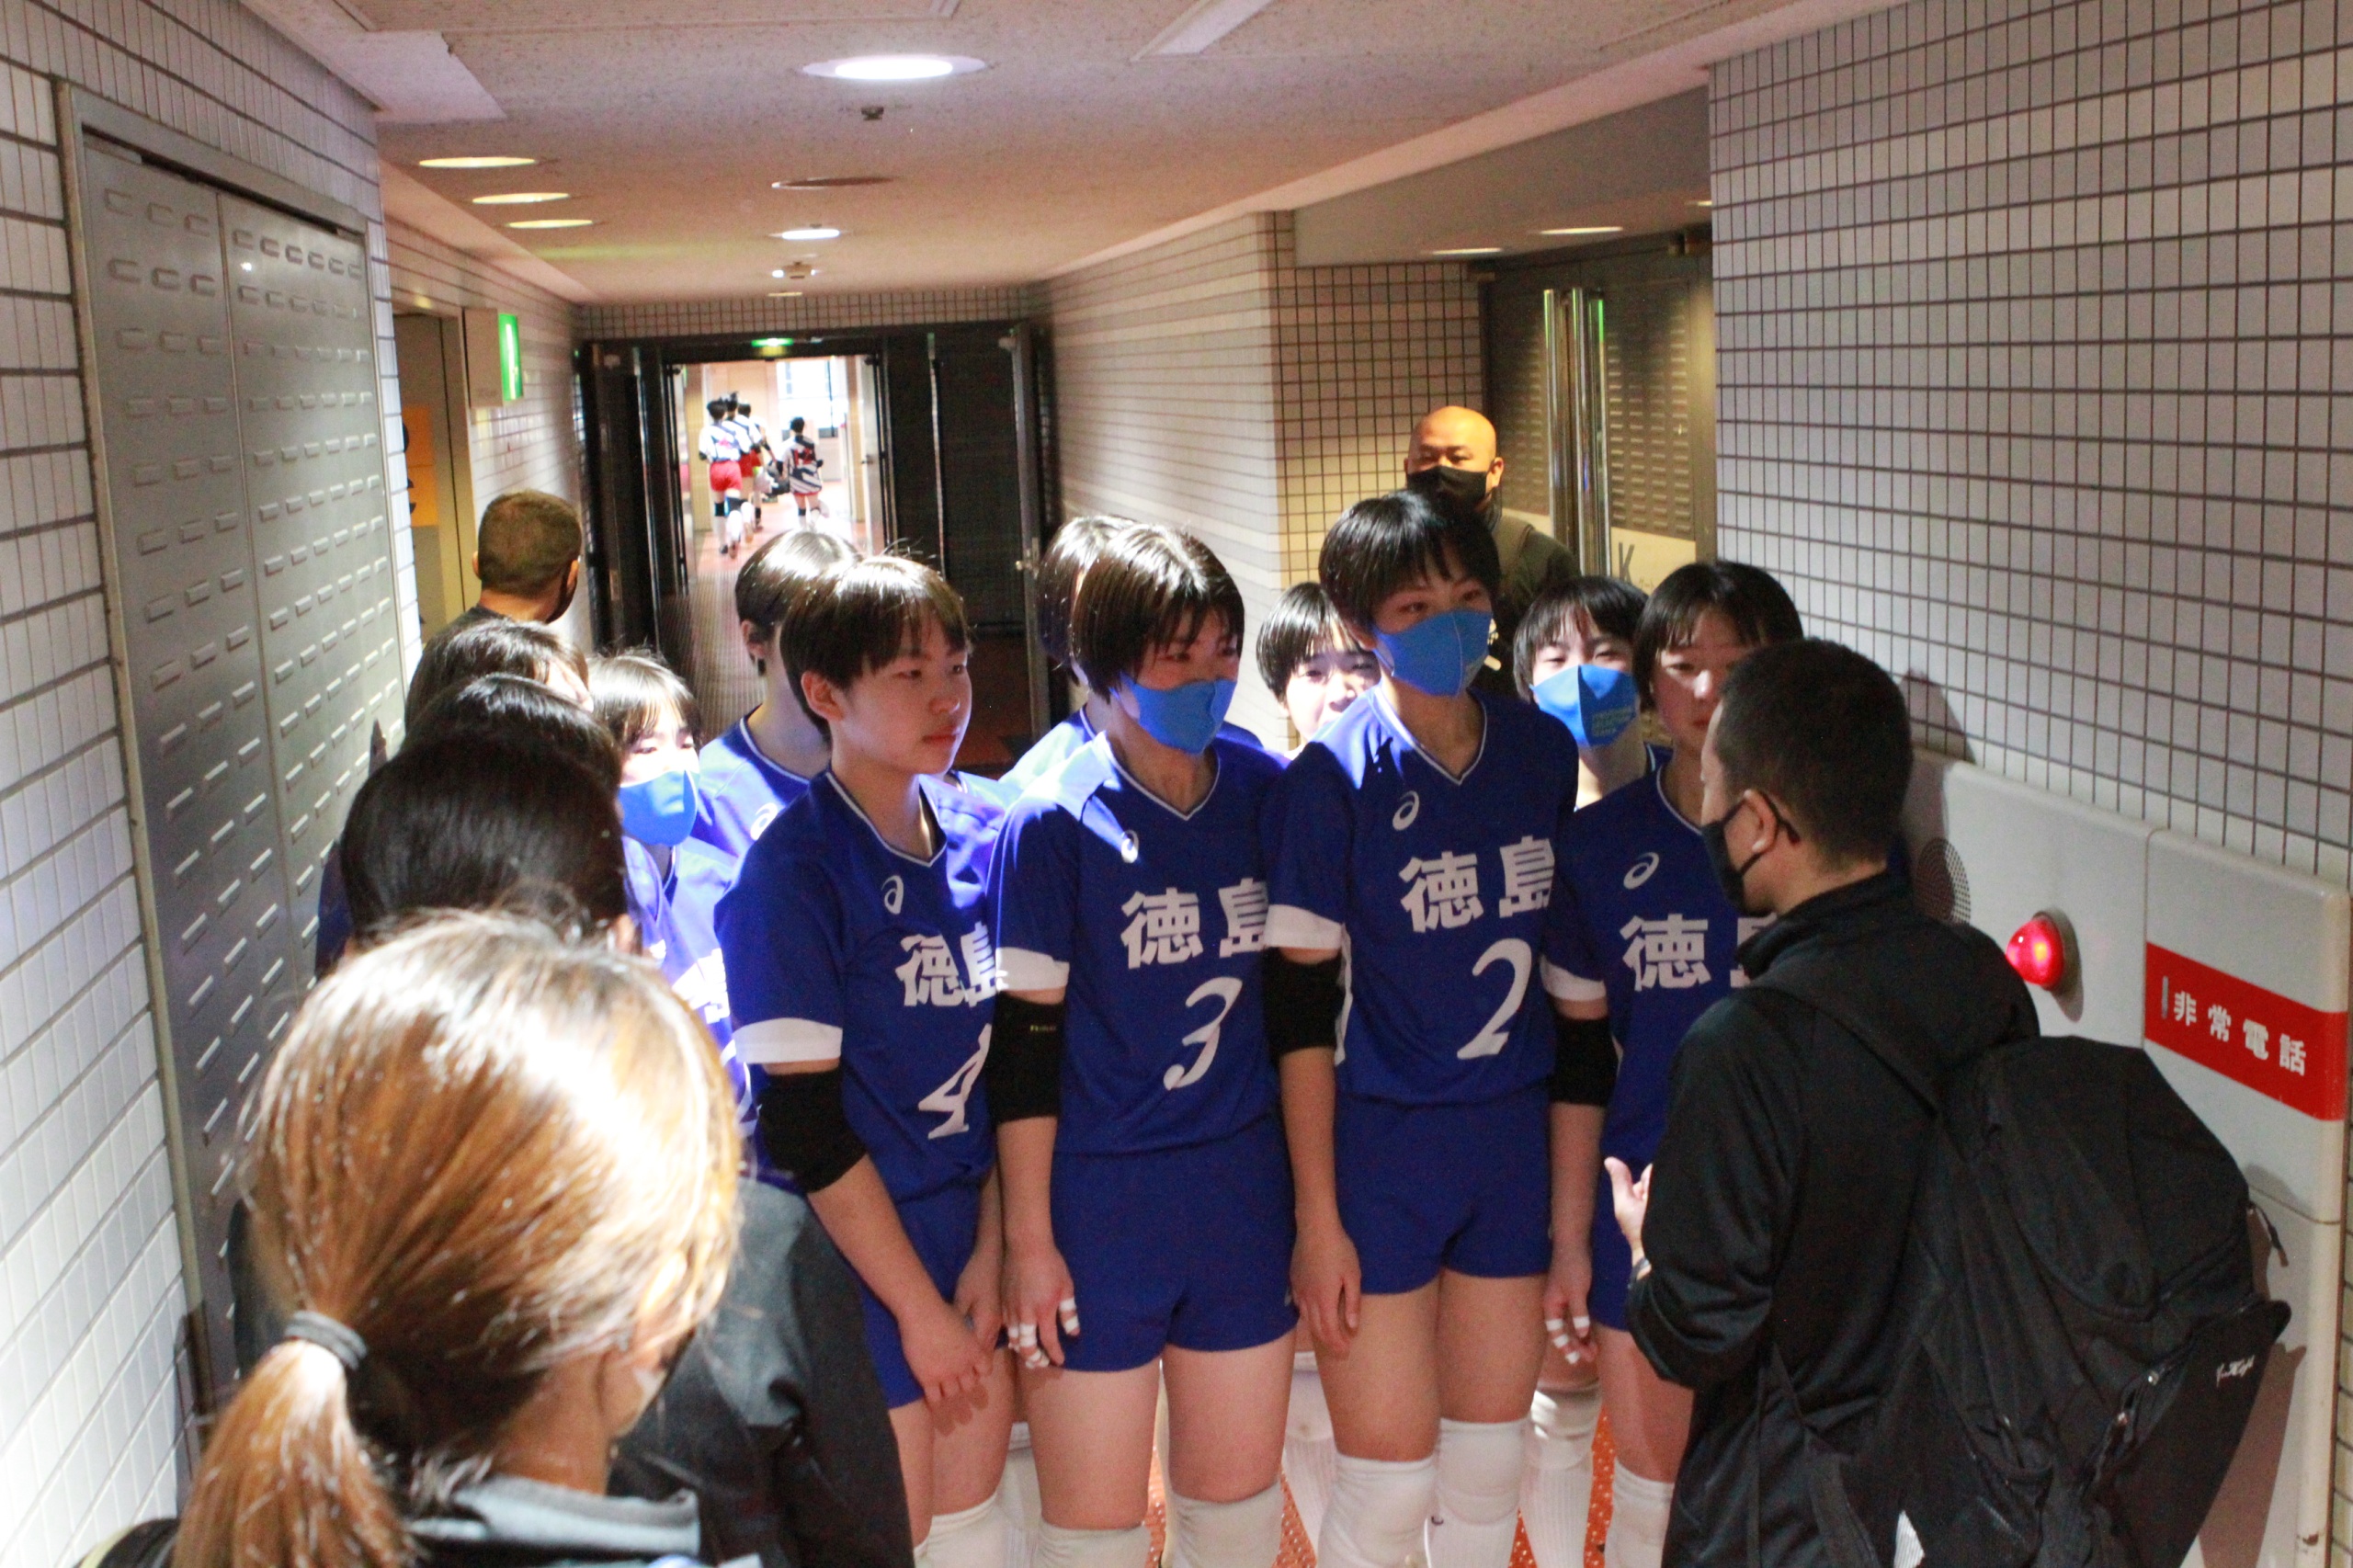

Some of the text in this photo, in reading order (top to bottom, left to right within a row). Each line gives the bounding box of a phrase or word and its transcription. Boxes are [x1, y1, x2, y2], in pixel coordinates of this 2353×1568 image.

[1619, 542, 1635, 584] K
[1120, 877, 1269, 970] 徳島
[1398, 835, 1555, 933] 徳島
[895, 920, 997, 1007] 徳島
[1457, 937, 1532, 1059] 2
[1163, 976, 1243, 1091] 3
[2174, 990, 2306, 1076] 非常電話
[917, 1023, 993, 1140] 4
